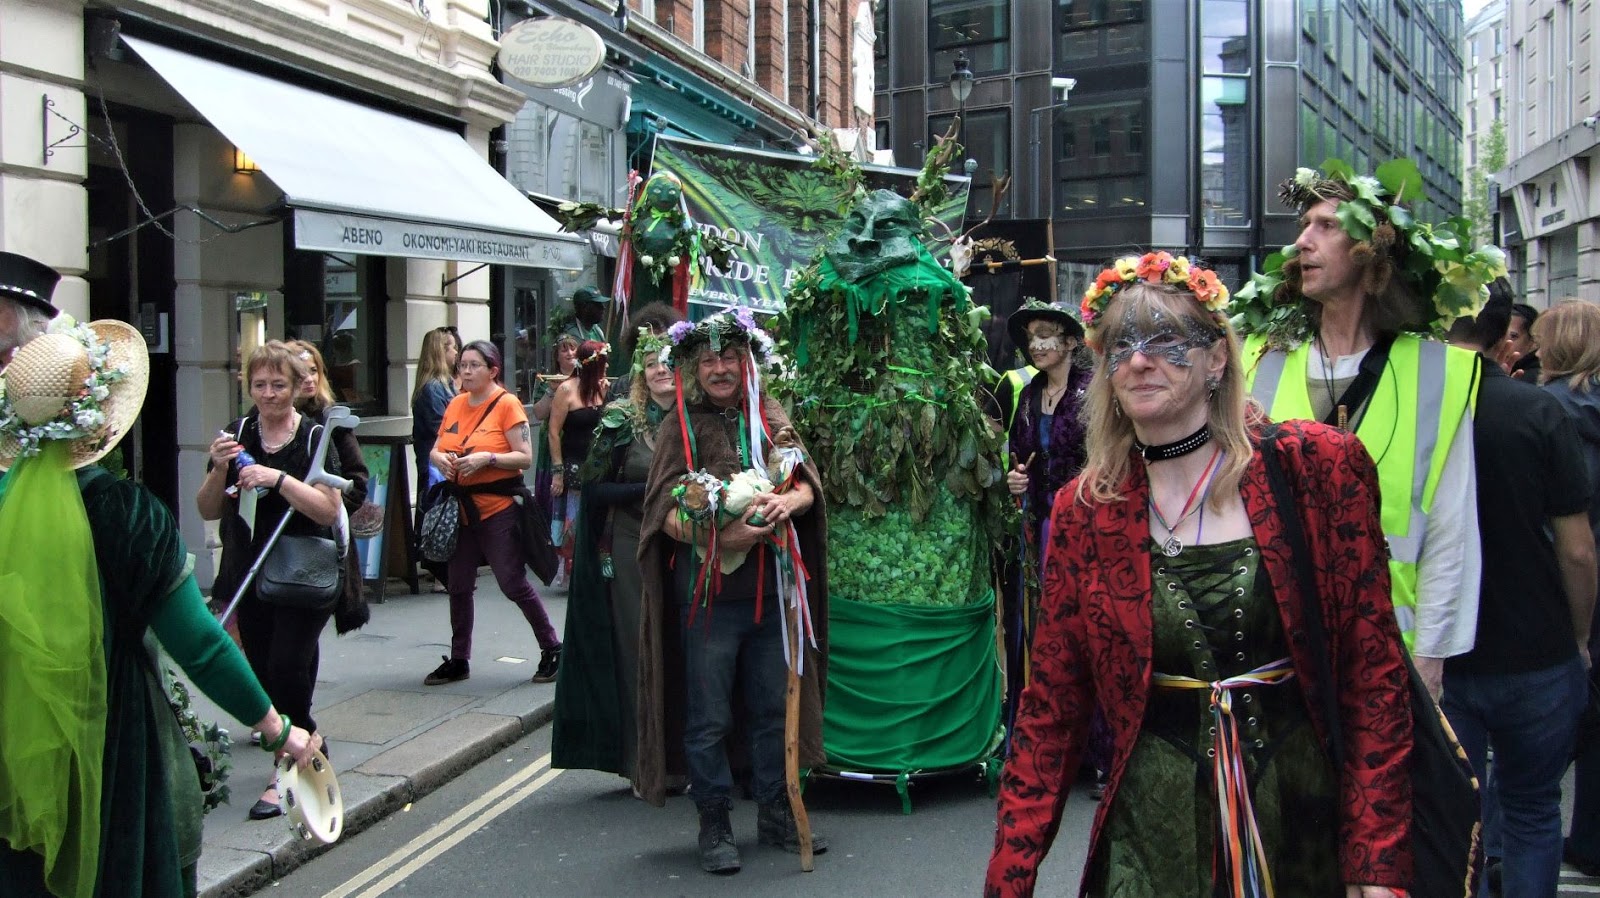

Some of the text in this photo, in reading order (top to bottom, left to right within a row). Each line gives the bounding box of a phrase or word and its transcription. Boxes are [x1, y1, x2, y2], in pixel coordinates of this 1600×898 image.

[515, 23, 577, 44] Echo
[508, 54, 591, 66] HAIR STUDIO
[514, 67, 531, 77] 020
[534, 67, 557, 77] 7405
[342, 227, 530, 259] ABENO OKONOMI-YAKI RESTAURANT
[689, 288, 786, 308] EVERY YEA
